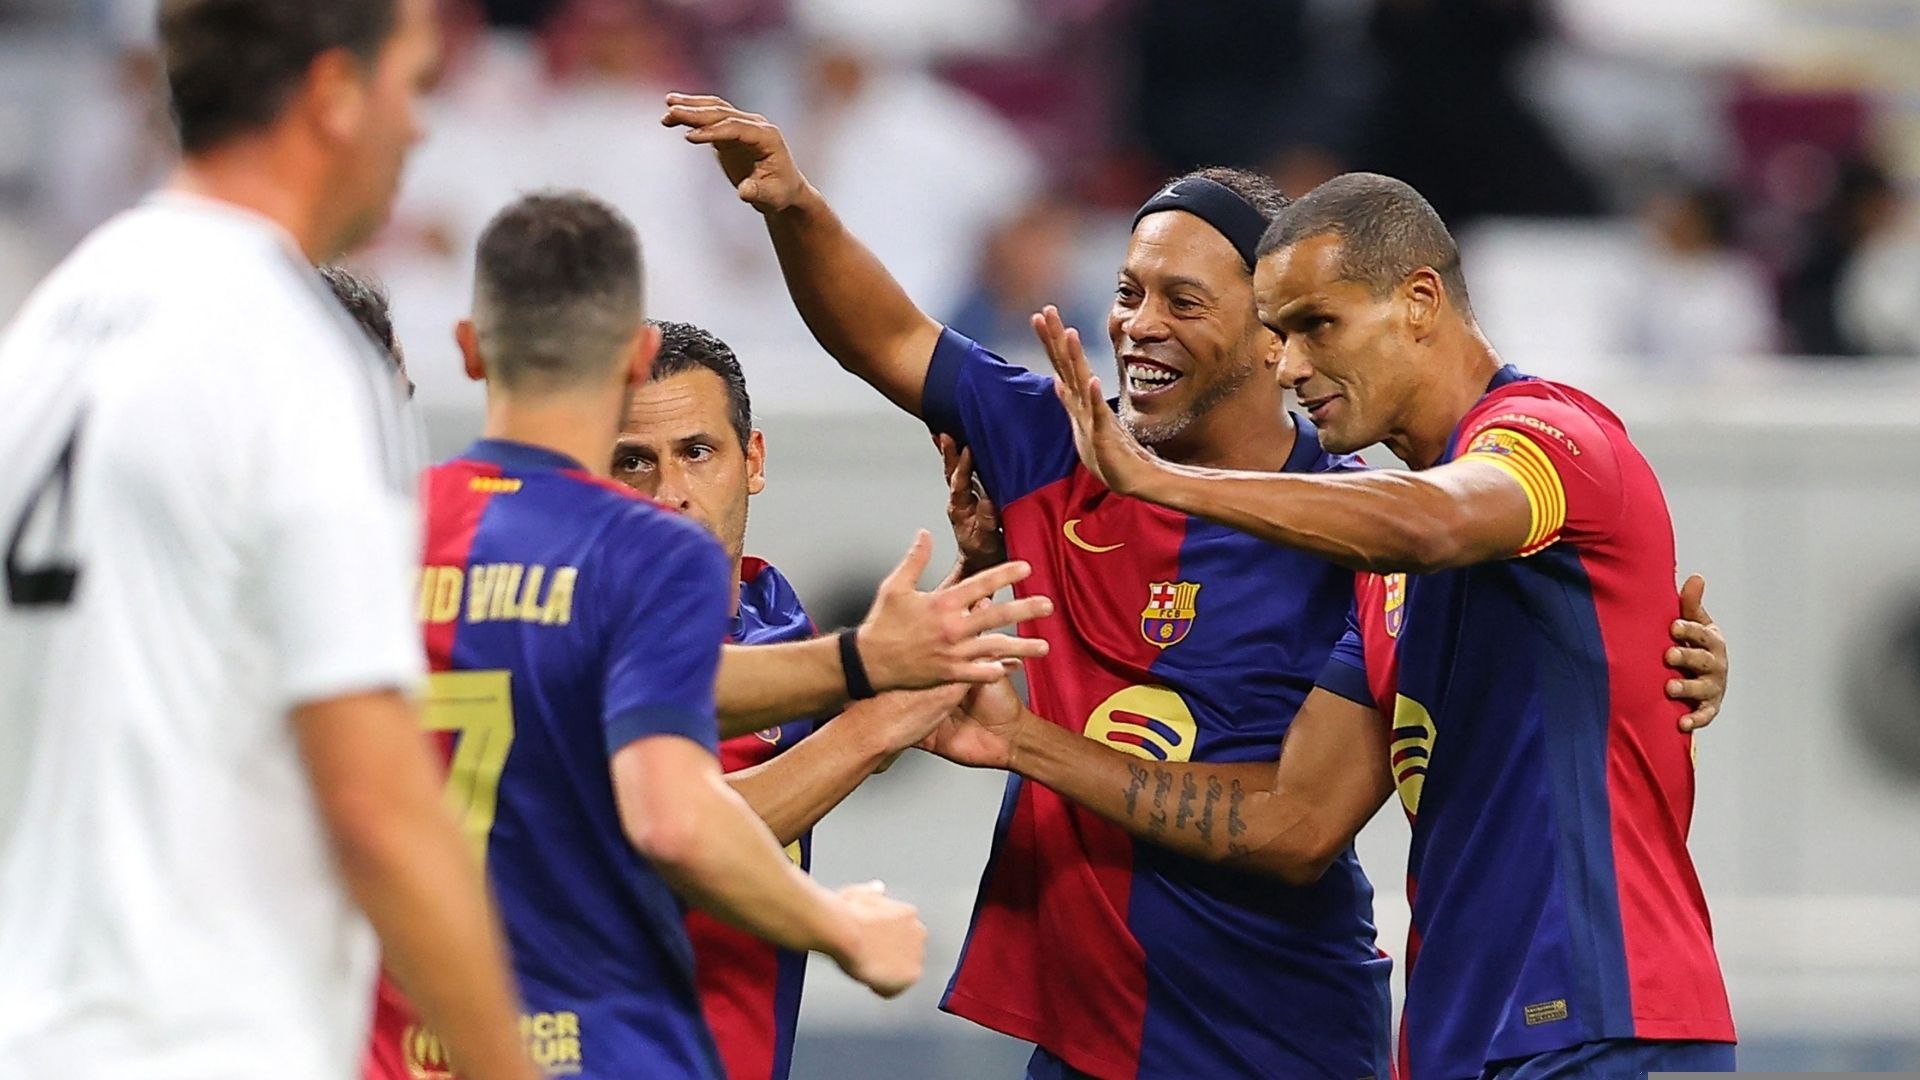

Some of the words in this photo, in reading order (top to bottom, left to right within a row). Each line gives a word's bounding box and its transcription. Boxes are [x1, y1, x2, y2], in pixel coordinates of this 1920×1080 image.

[5, 412, 82, 606] 4
[419, 564, 464, 623] ID
[467, 563, 578, 625] VILLA
[421, 670, 515, 876] 7
